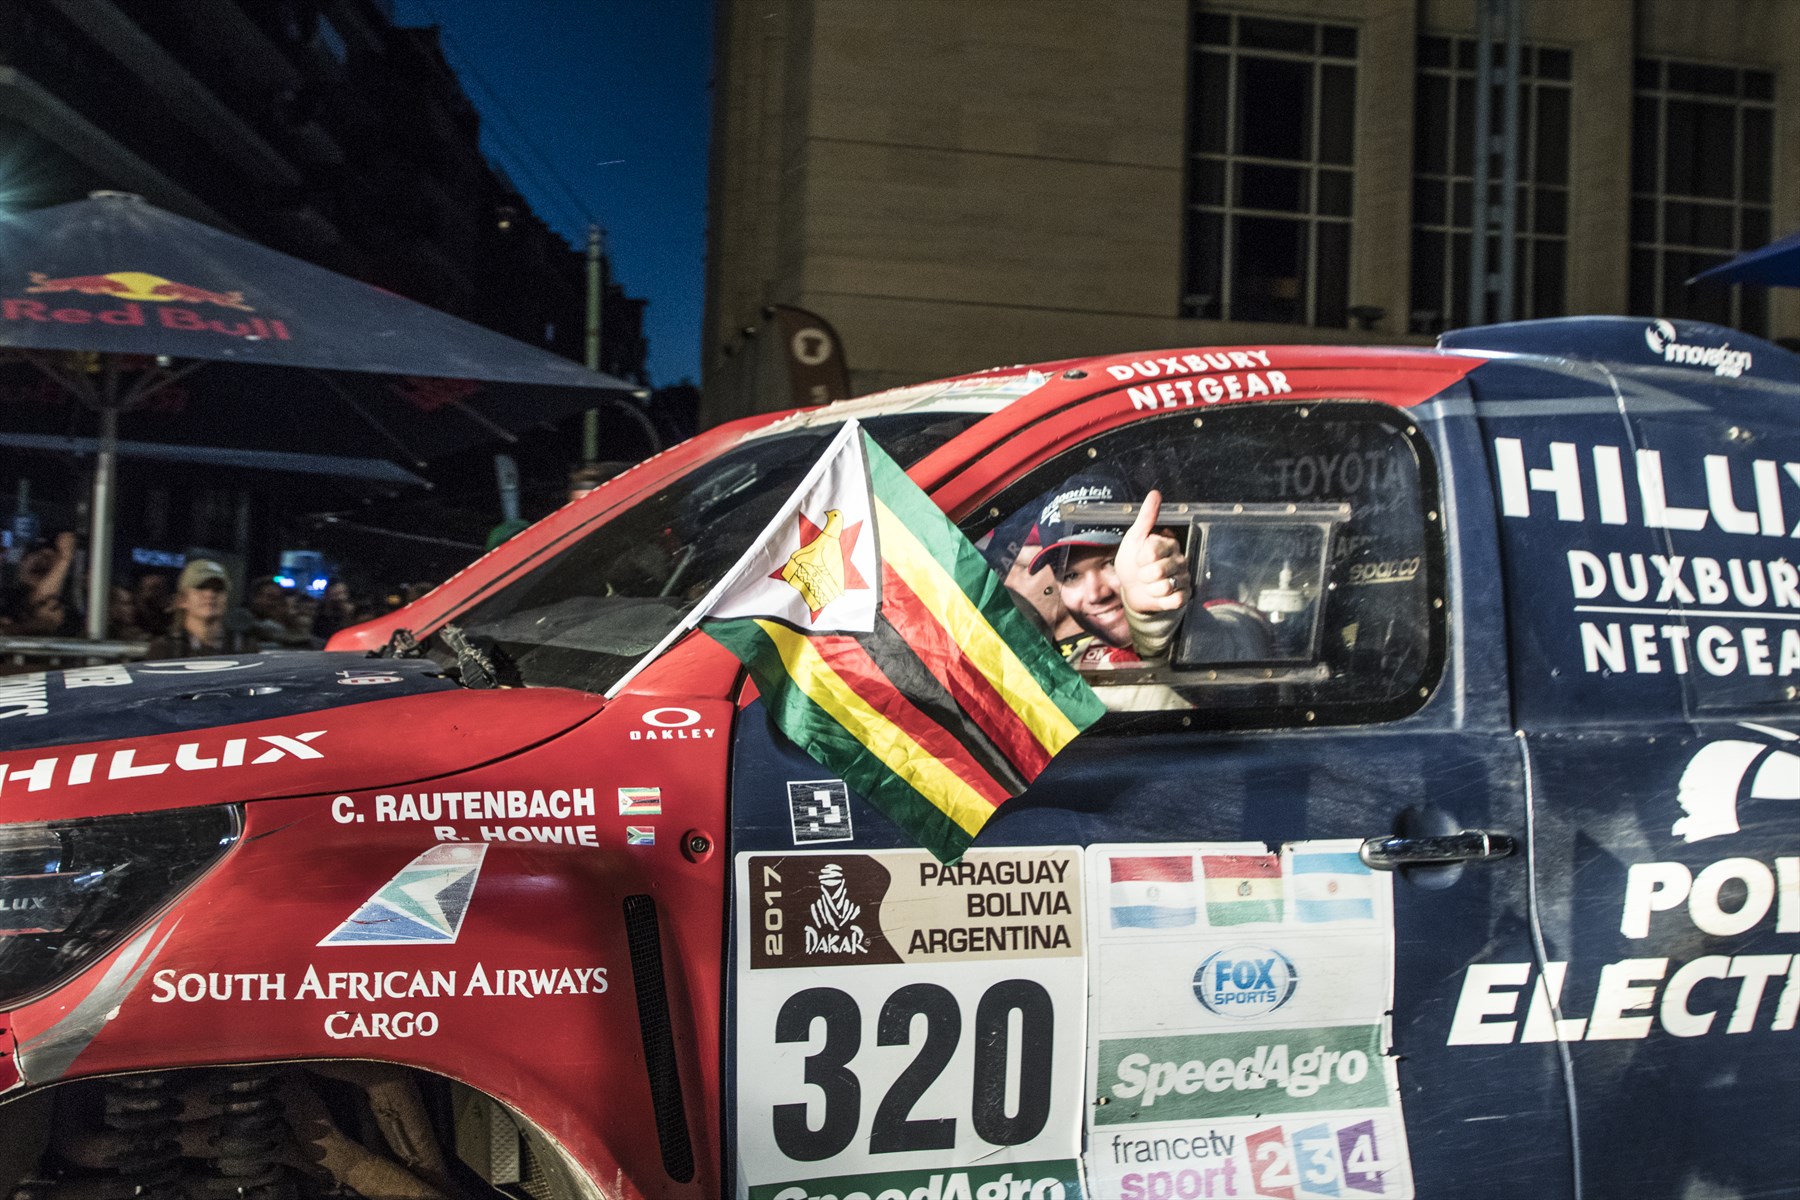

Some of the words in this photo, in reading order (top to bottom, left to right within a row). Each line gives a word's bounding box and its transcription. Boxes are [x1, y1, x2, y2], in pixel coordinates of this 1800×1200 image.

[2, 300, 146, 327] Red
[158, 307, 292, 341] Bull
[1106, 350, 1271, 381] DUXBURY
[1127, 370, 1292, 410] NETGEAR
[1272, 450, 1409, 497] TOYOTA
[629, 728, 716, 741] OAKLEY
[0, 730, 327, 793] HILUX
[331, 796, 364, 824] C.
[376, 788, 595, 822] RAUTENBACH
[434, 826, 469, 841] R.
[480, 825, 600, 848] HOWIE
[920, 860, 1070, 886] PARAGUAY
[763, 866, 783, 956] 2017
[967, 891, 1072, 917] BOLIVIA
[804, 925, 868, 955] DAKAR
[907, 925, 1071, 955] ARGENTINA
[152, 969, 286, 1003] SOUTH
[294, 963, 456, 1002] AFRICAN
[463, 961, 608, 998] AIRWAYS
[1215, 958, 1276, 991] FOX
[1214, 990, 1277, 1005] SPORTS
[324, 1011, 439, 1041] CARGO
[773, 978, 1055, 1162] 320
[1111, 1043, 1369, 1107] SpeedAgro
[1257, 1141, 1302, 1189] 2
[1304, 1138, 1339, 1184] 3
[1346, 1134, 1393, 1181] 4
[771, 1172, 1066, 1200] dAgro
[1120, 1158, 1238, 1200] sport
